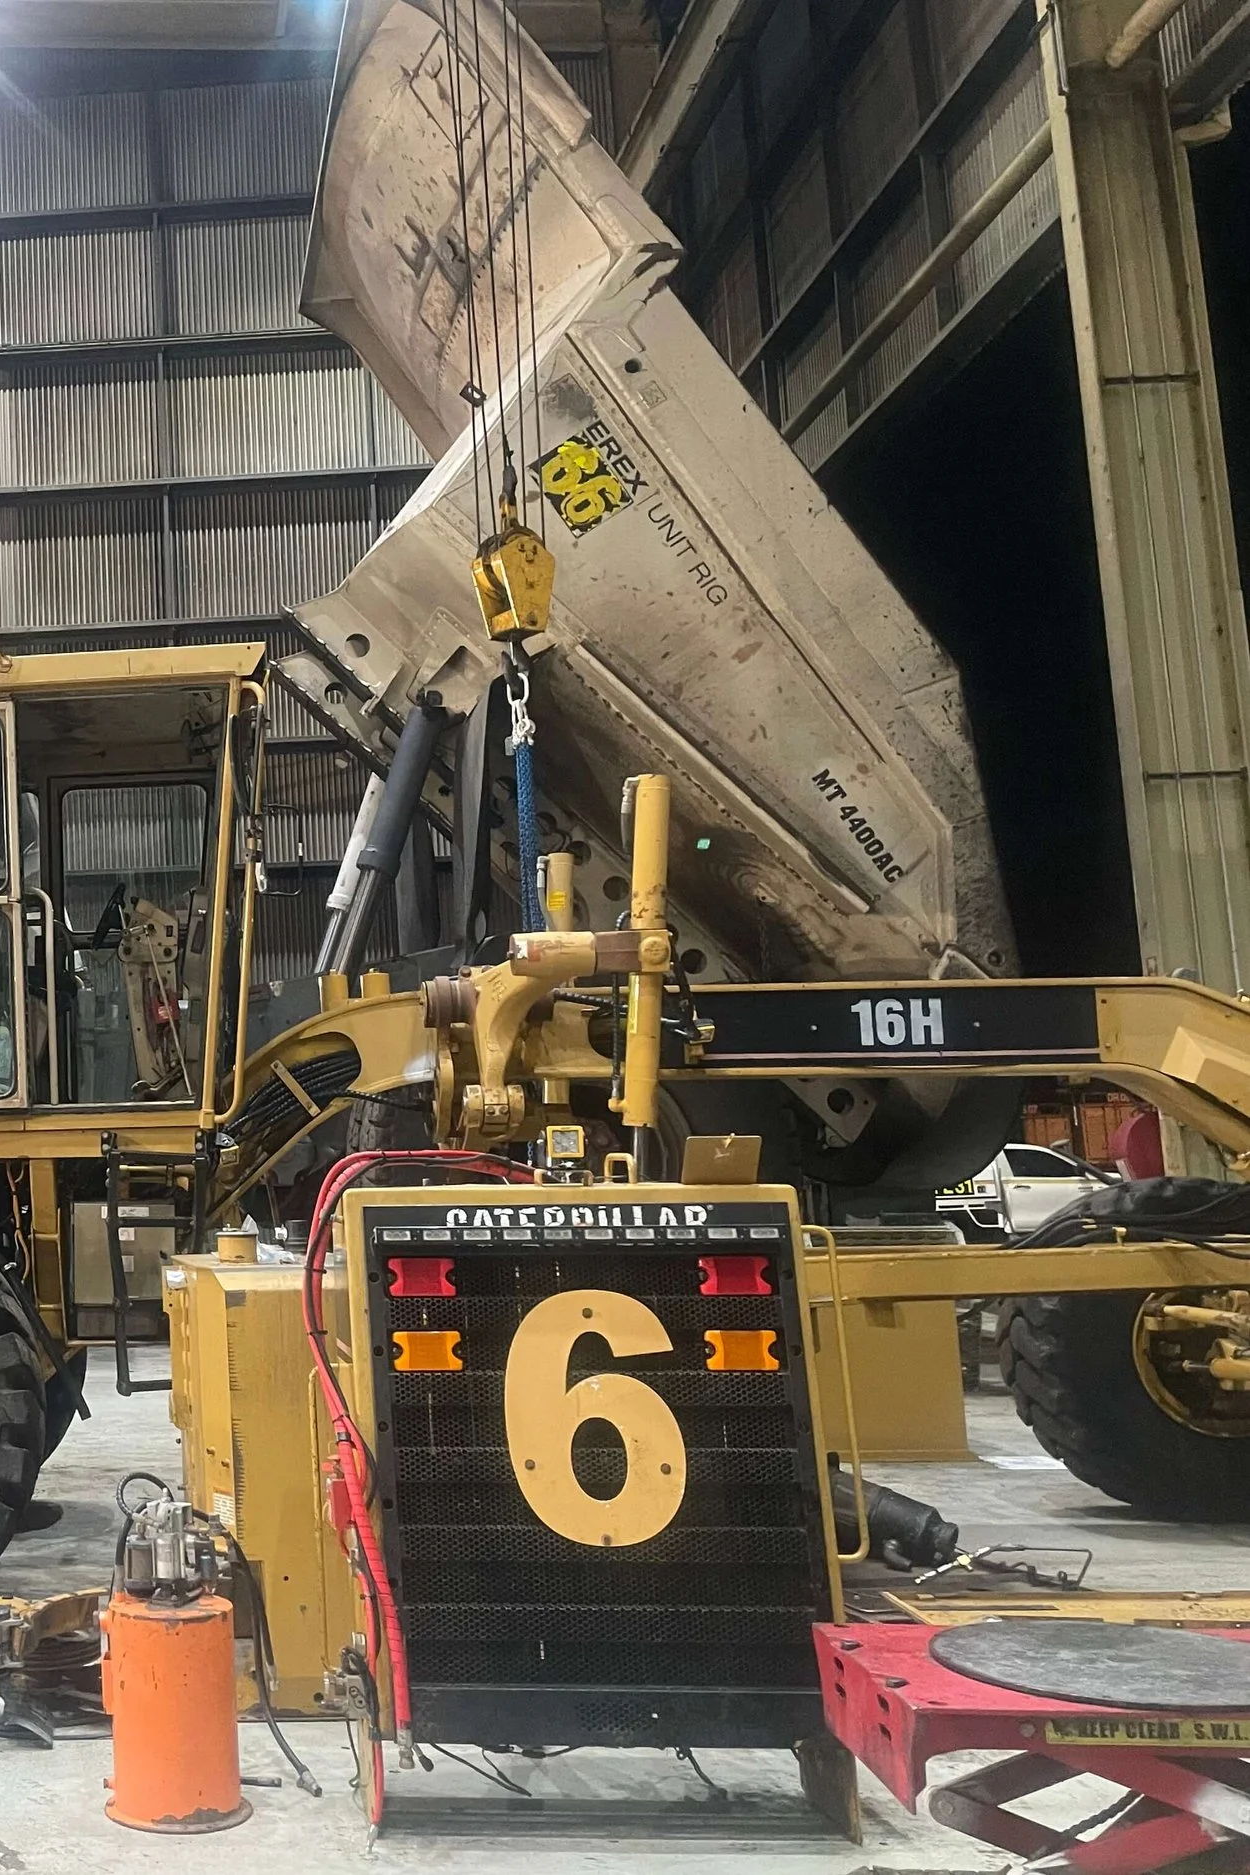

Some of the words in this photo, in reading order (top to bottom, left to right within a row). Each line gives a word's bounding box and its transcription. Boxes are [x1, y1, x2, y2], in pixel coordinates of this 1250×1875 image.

[585, 419, 649, 497] EREX
[648, 502, 698, 557] UNIT
[688, 561, 728, 607] RIG
[812, 768, 847, 802] MT
[839, 805, 904, 883] 4400AC
[850, 998, 945, 1047] 16H
[504, 1289, 687, 1547] 6
[1125, 1721, 1180, 1739] CLEAR
